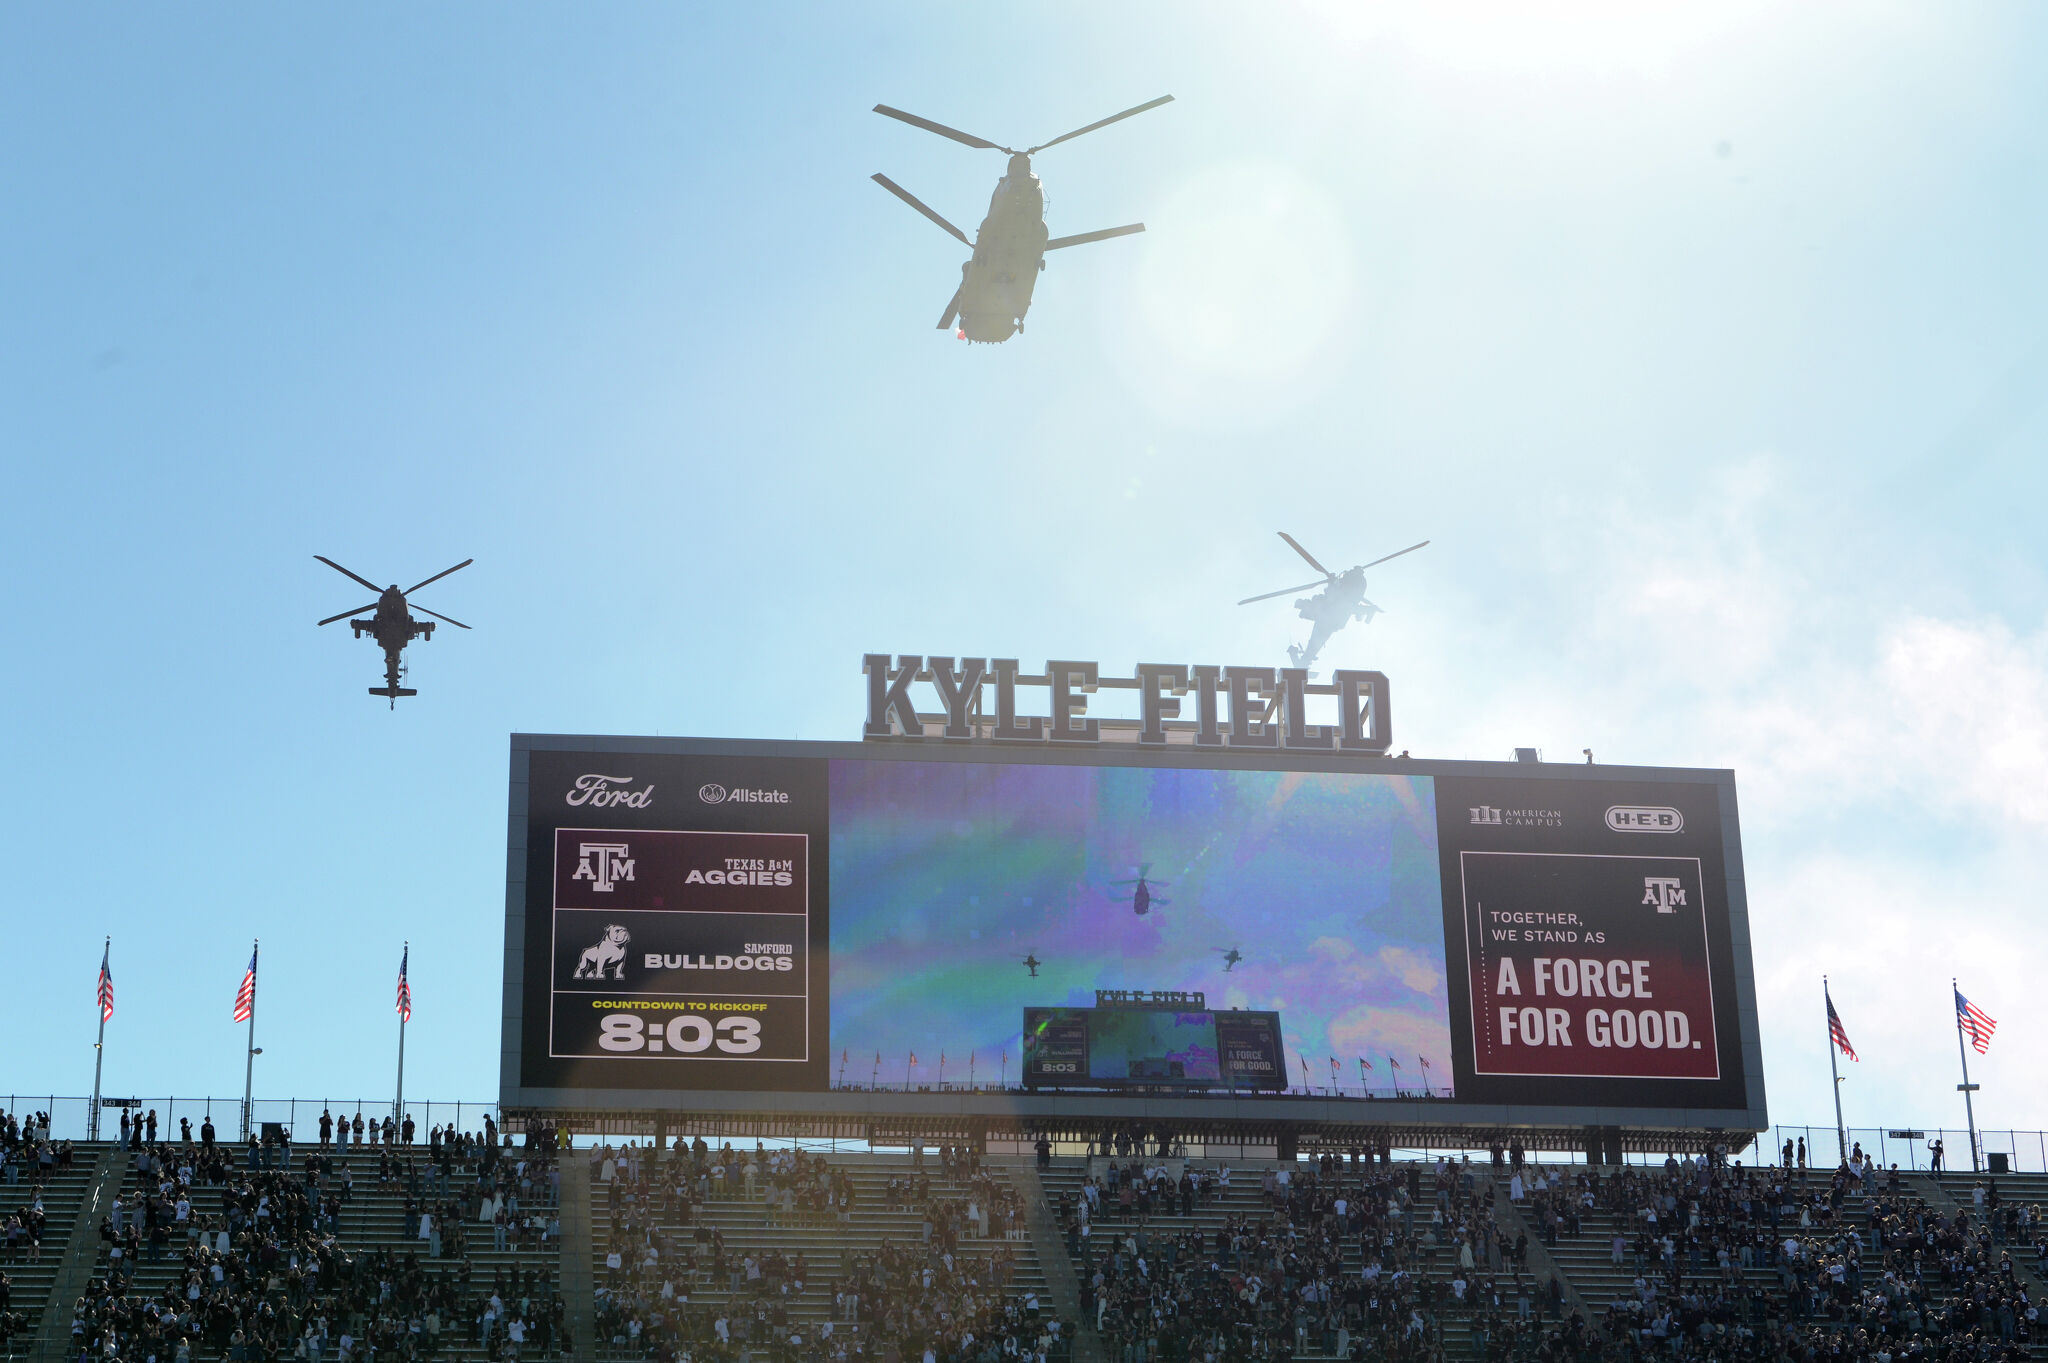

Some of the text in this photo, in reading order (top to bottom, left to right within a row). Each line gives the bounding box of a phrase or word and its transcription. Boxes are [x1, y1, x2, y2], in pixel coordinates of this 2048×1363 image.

[862, 653, 1393, 754] KYLE FIELD
[566, 774, 654, 809] Ford
[727, 788, 789, 804] Allstate
[1505, 809, 1561, 818] AMERICAN
[1615, 812, 1674, 827] H-E-B
[1505, 817, 1562, 827] CAMPUS
[725, 858, 793, 872] TEXAS A&M
[685, 870, 793, 886] AGGIES
[1490, 911, 1583, 927] TOGETHER,
[1491, 929, 1606, 944] WE STAND AS
[744, 943, 793, 955] SAMFORD
[644, 953, 793, 971] BULLDOGS
[1497, 957, 1653, 998] A FORCE
[592, 1000, 768, 1012] COUNTDOWN TO KICKOFF
[598, 1013, 761, 1054] 8:03
[1499, 1006, 1702, 1050] FOR GOOD.
[1236, 1050, 1263, 1060] FORCE
[1042, 1063, 1077, 1072] 8:03
[1230, 1060, 1245, 1070] FOR
[1369, 1299, 1378, 1309] 12
[758, 1311, 766, 1320] 12
[192, 1322, 201, 1332] 12
